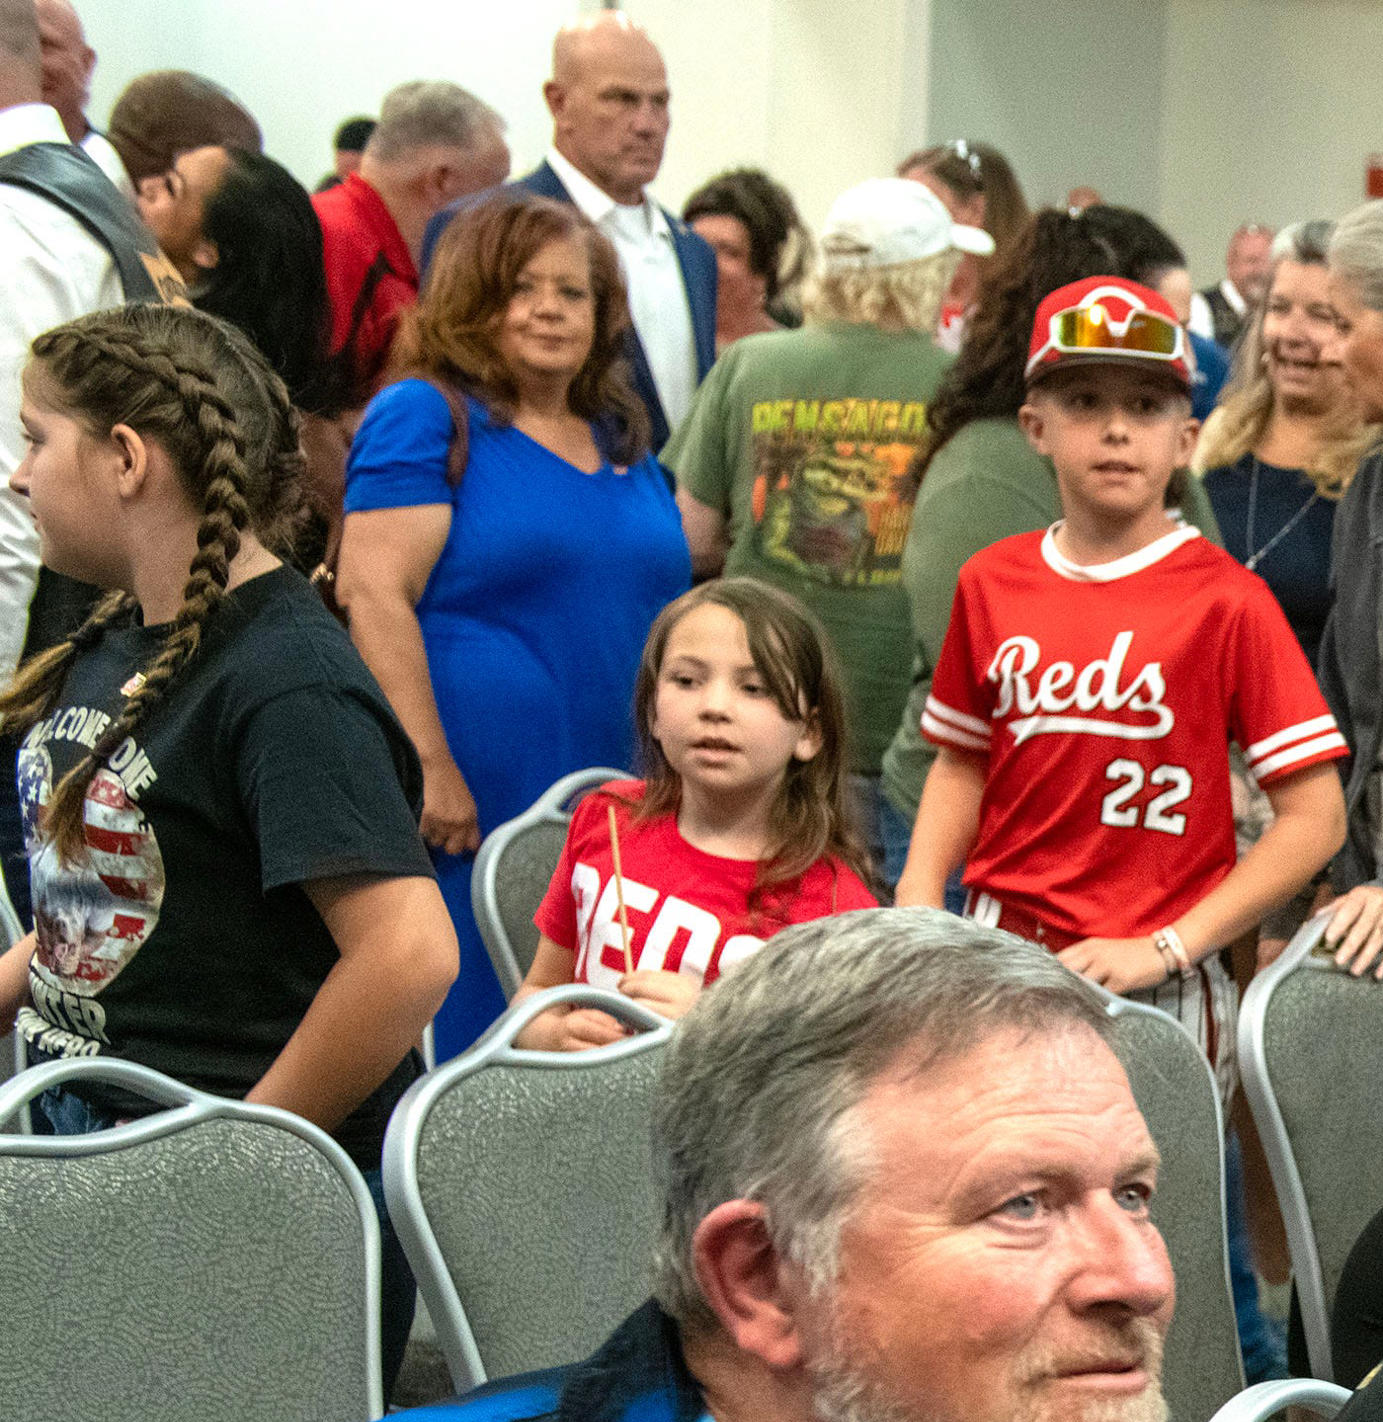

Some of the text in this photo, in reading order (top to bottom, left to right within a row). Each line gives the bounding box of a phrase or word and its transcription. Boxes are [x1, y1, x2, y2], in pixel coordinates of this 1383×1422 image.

[988, 631, 1174, 742] Reds
[109, 735, 158, 800] OME
[1101, 758, 1193, 835] 22
